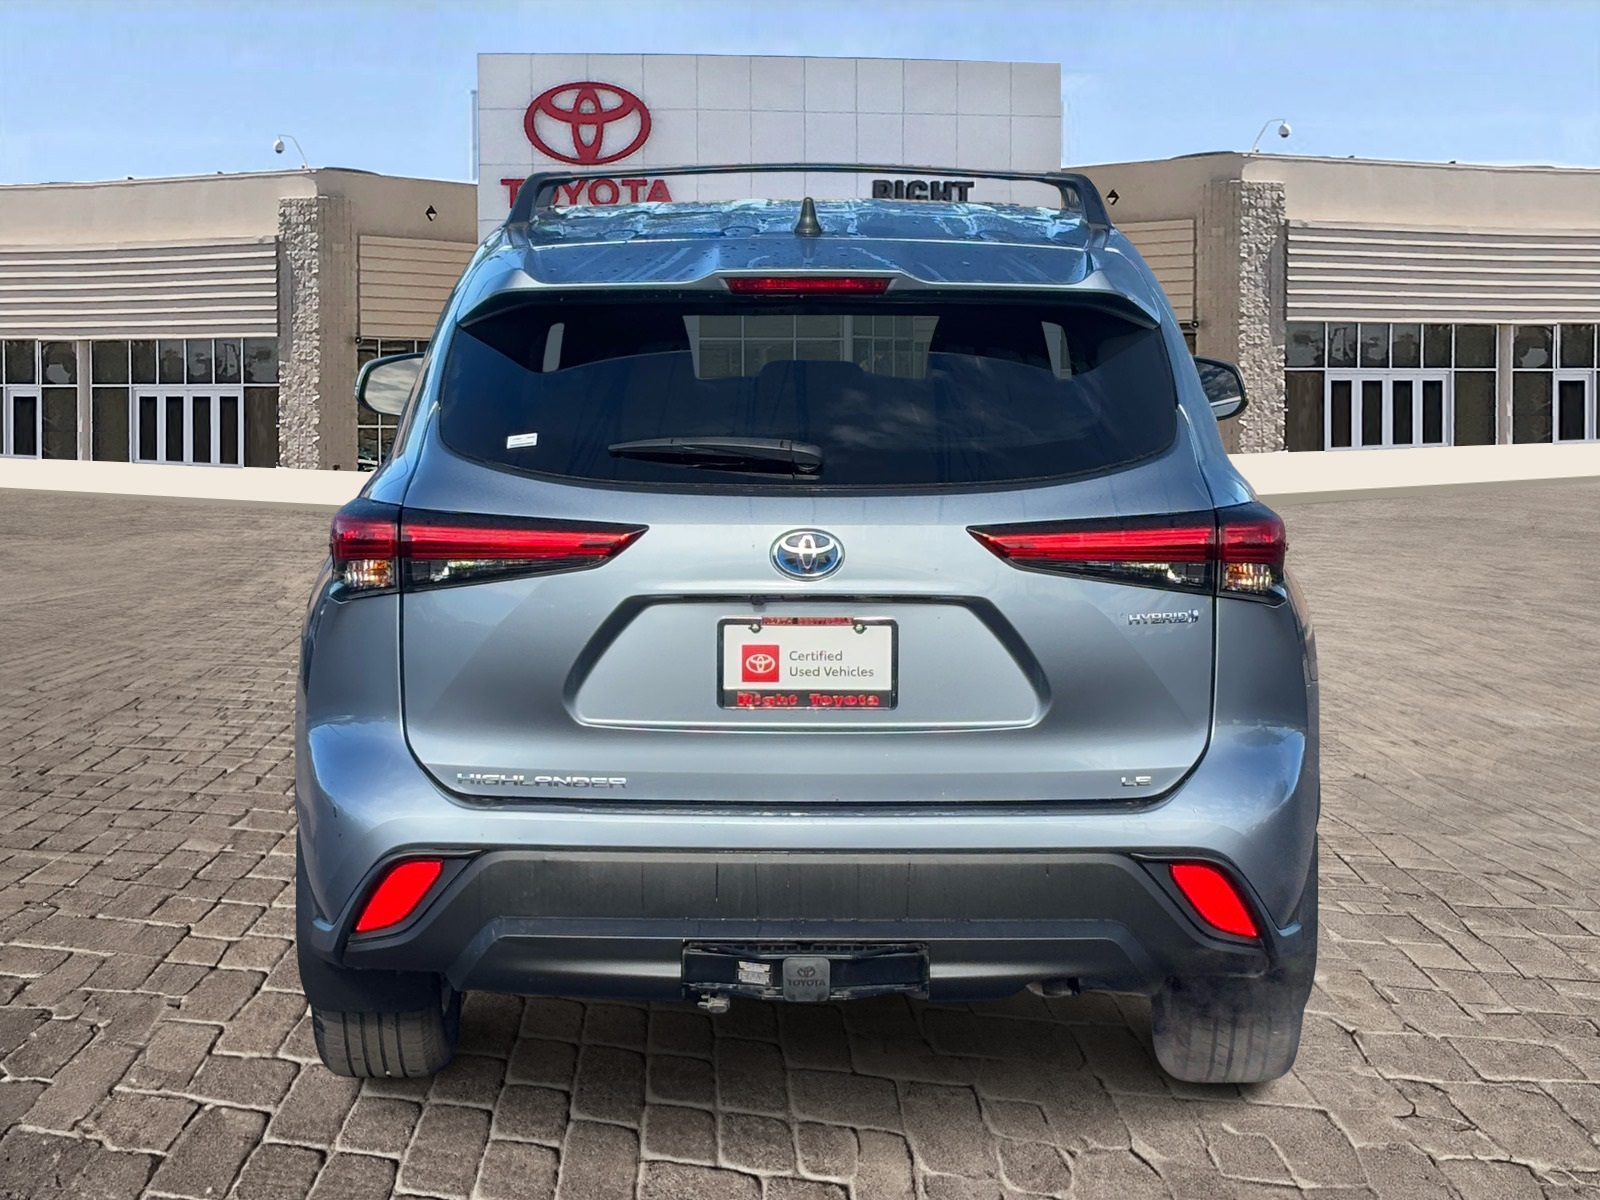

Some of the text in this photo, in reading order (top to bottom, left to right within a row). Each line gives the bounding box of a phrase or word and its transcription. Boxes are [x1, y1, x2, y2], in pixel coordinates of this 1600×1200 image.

[1128, 611, 1189, 625] HYBRID
[789, 650, 843, 662] Certified
[789, 665, 874, 678] Used Vehicles
[809, 693, 880, 706] Toyota
[456, 772, 627, 789] HIGHLANDER
[1121, 775, 1152, 787] LE
[787, 979, 827, 987] TOYOTA
